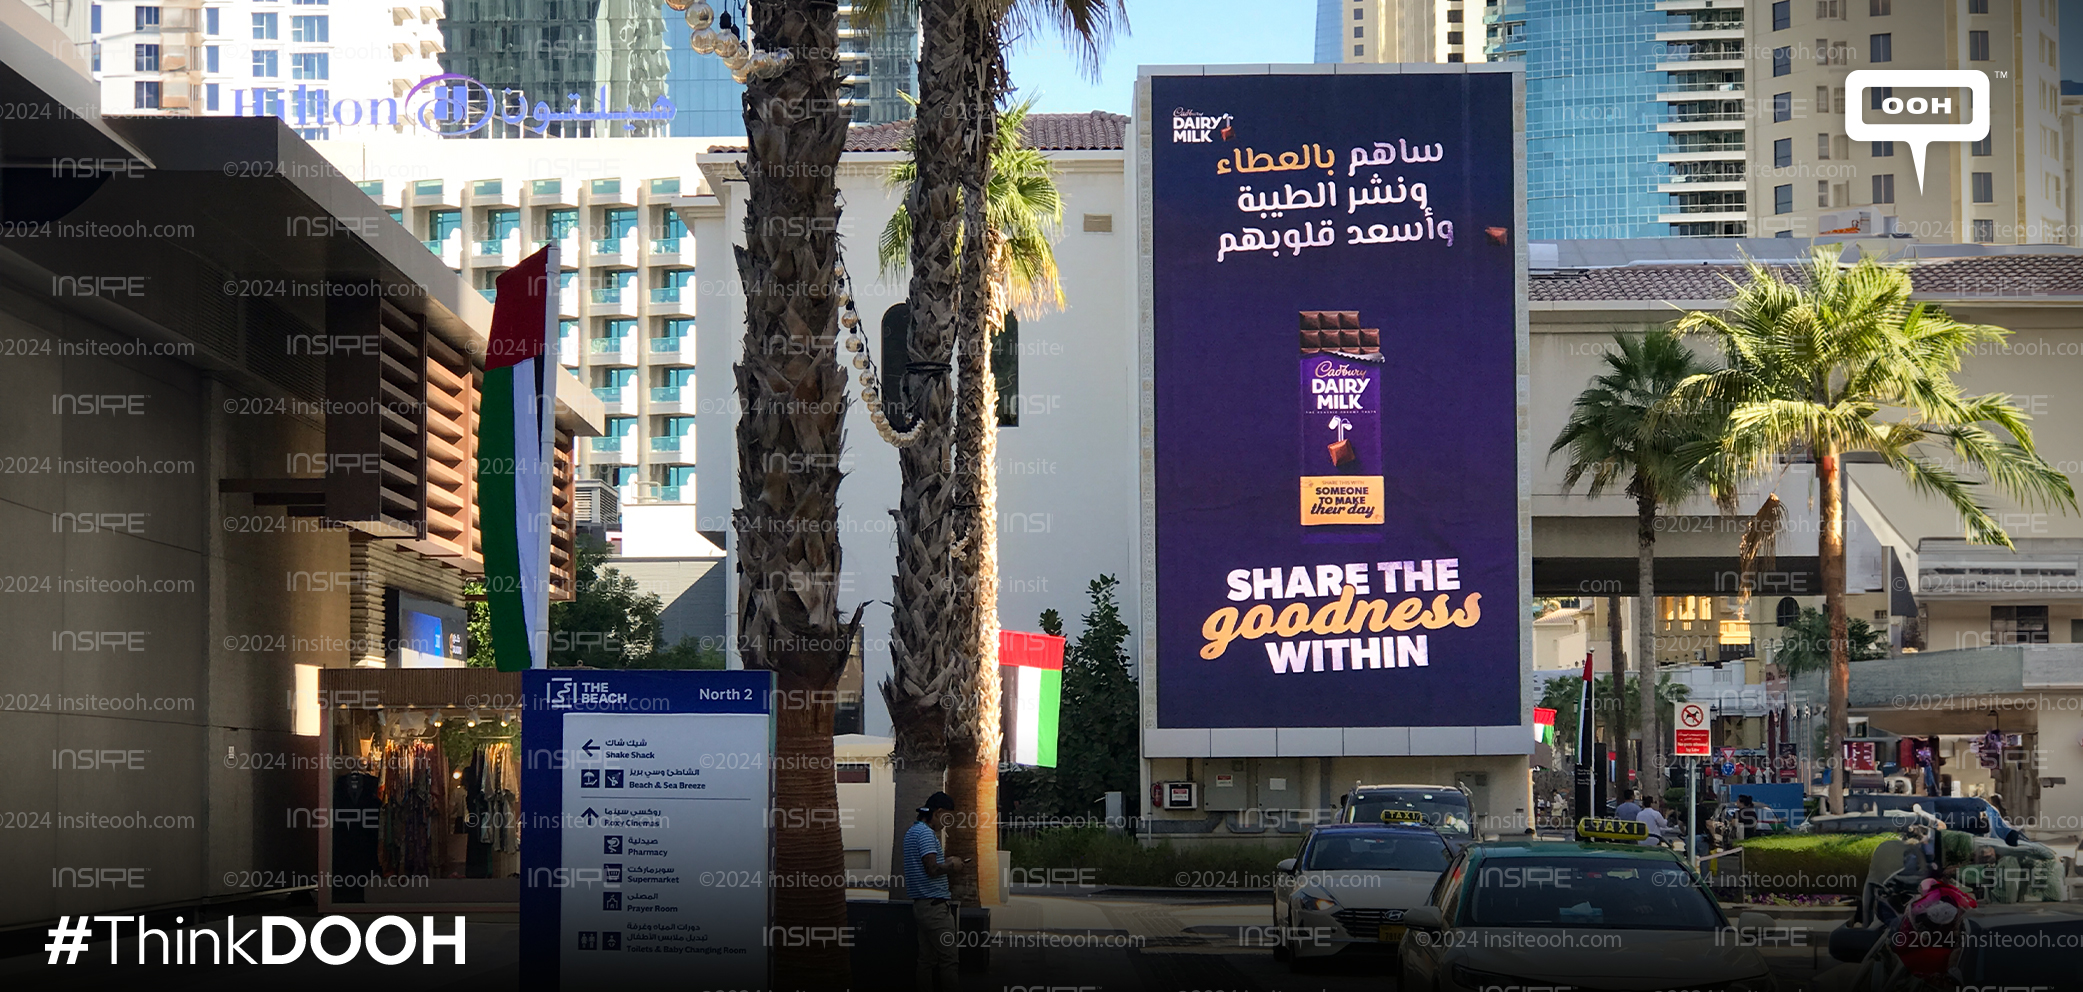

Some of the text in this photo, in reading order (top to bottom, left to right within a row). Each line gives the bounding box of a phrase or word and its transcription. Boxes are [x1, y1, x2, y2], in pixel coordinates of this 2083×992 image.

[230, 84, 400, 126] Hilton
[501, 85, 678, 134] هيلتون
[1173, 116, 1222, 130] DAIRY
[1173, 130, 1213, 143] MILK
[1216, 138, 1444, 177] ساهم بالعطاء
[1237, 173, 1428, 220] ونشر الطيبة
[1217, 206, 1454, 263] وأسعد قلوبهم
[1315, 361, 1367, 378] Cadbury
[1312, 378, 1371, 394] DAIRY
[1317, 394, 1364, 410] MILK
[1315, 487, 1369, 495] SOMEONE
[1319, 497, 1366, 505] TO MAKE
[1311, 503, 1375, 518] their day
[1226, 558, 1461, 602] SHARE THE
[1199, 584, 1483, 660] goodness
[1264, 634, 1430, 674] WITHIN
[582, 682, 609, 693] THE
[581, 693, 627, 704] BEACH
[699, 688, 753, 700] North 2
[605, 738, 648, 747] شيك شاك
[605, 750, 655, 759] Shake Shack
[666, 768, 700, 777] الشاطئ
[629, 781, 706, 790] Beach & Sea Breeze
[604, 808, 629, 817] سينما
[1389, 811, 1418, 820] TAXI
[604, 820, 660, 829] Roxy Cinemas
[1593, 820, 1639, 834] TAXI
[628, 837, 659, 846] صيدلية
[628, 849, 668, 857] Pharmacy
[627, 866, 675, 875] سوبرماركت
[627, 875, 679, 884] Supermarket
[627, 905, 678, 913] Prayer Room
[627, 945, 653, 953] Toilets
[663, 946, 683, 954] Baby
[685, 946, 722, 955] Changing
